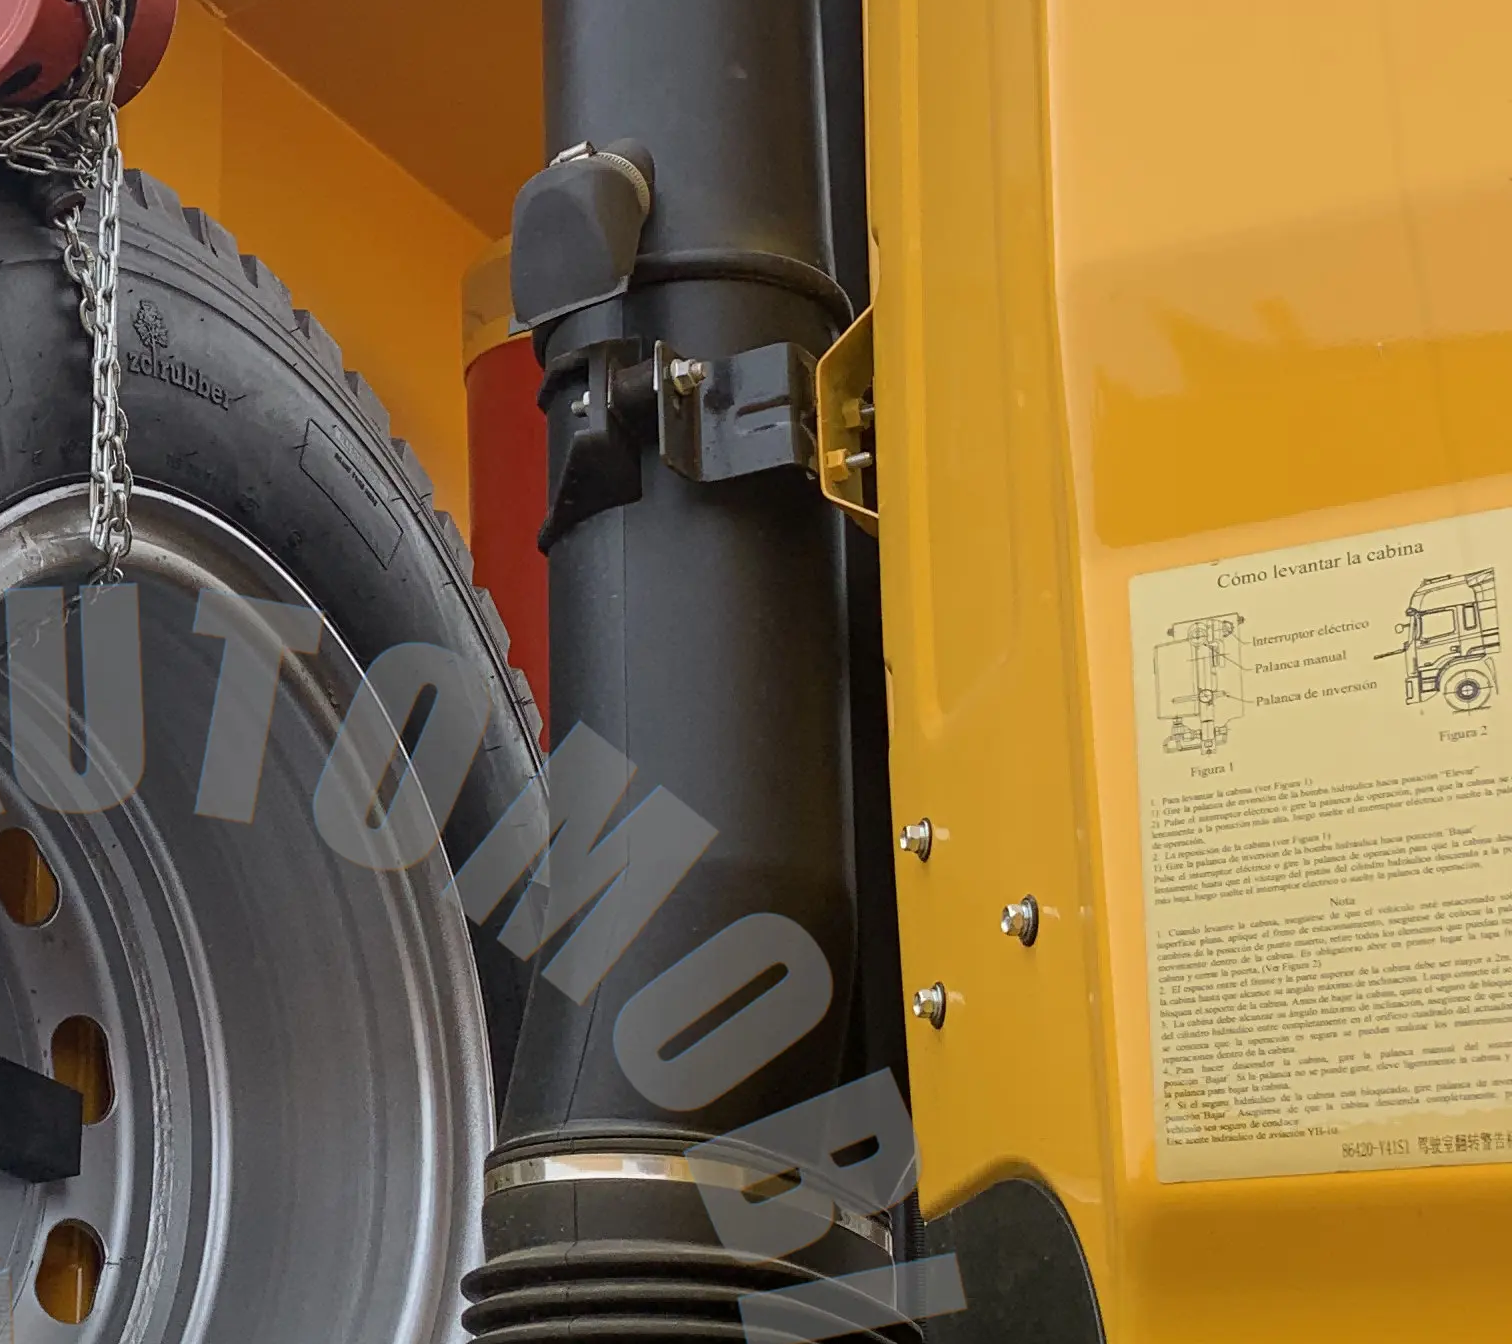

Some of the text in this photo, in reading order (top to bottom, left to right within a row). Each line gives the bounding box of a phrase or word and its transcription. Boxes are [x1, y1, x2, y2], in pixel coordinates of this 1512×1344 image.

[1217, 541, 1424, 589] Cómo levantar la cabina
[1252, 619, 1370, 648] Interruptor eléctrico
[1255, 651, 1347, 674] Palanca manual
[1256, 679, 1378, 706] Palanca de inversión
[1439, 726, 1488, 742] Figura 2
[1190, 766, 1225, 778] Figura
[1329, 895, 1355, 907] Nota
